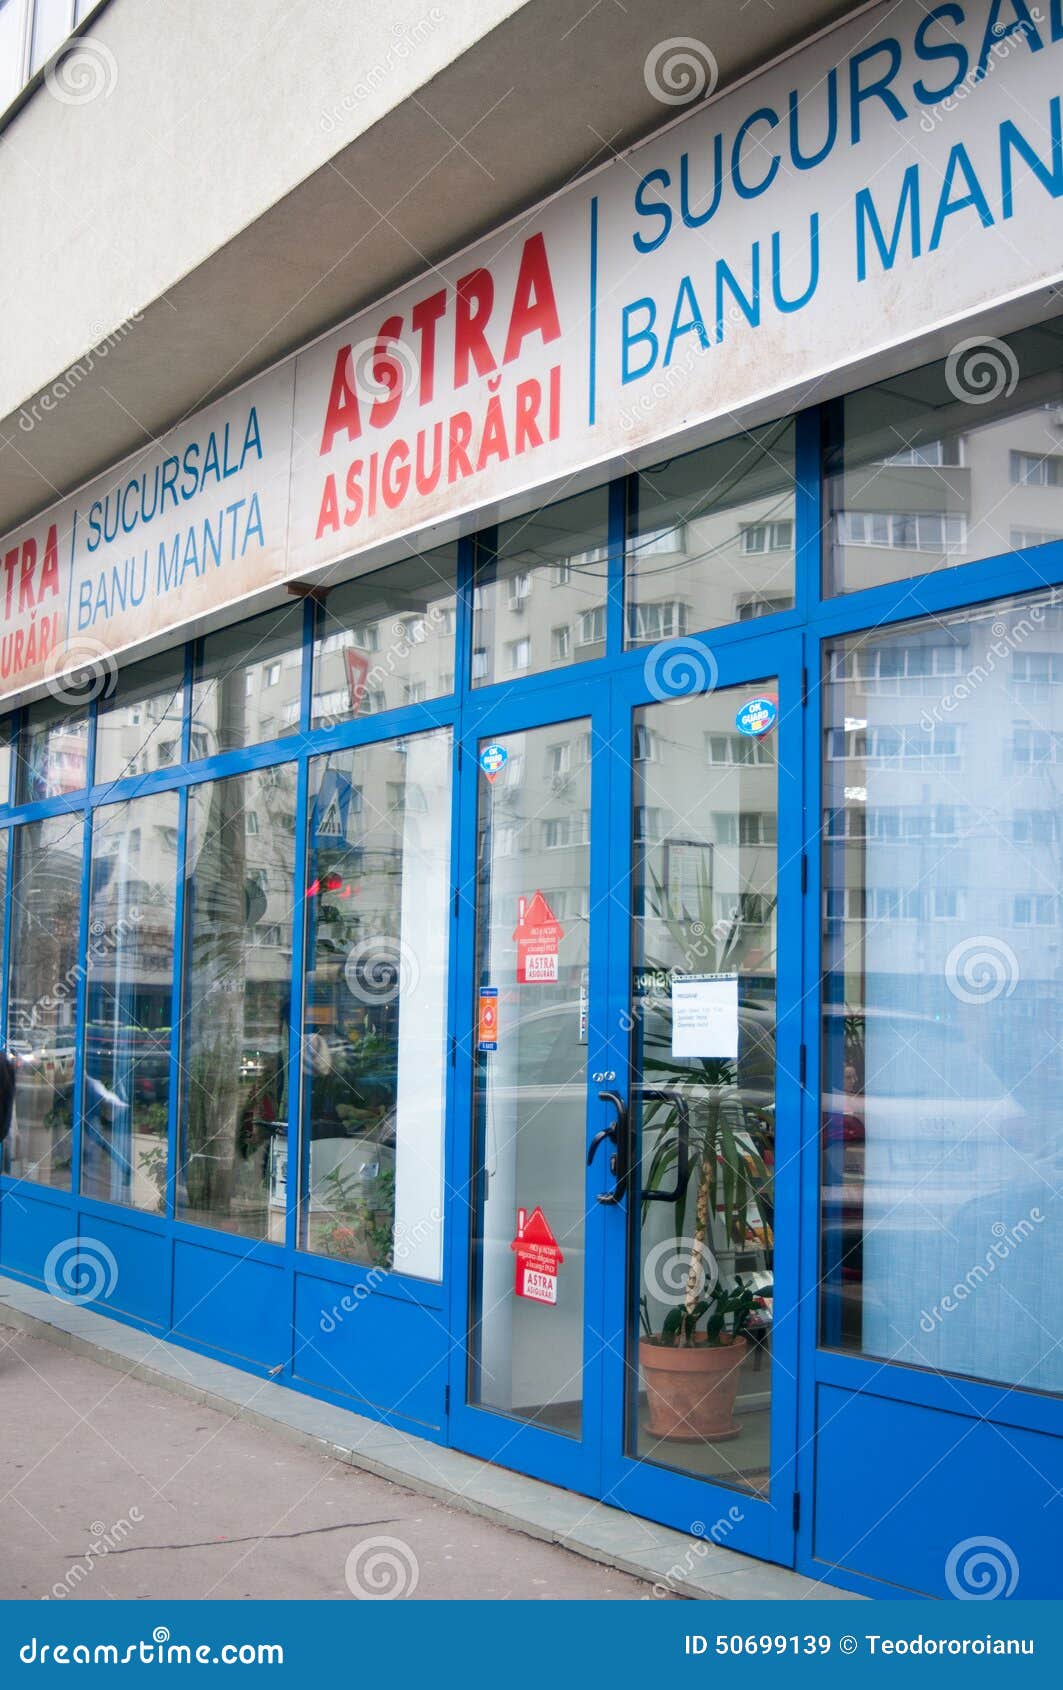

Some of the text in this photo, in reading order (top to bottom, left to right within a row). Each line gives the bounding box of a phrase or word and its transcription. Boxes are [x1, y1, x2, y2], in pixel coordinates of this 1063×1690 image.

[633, 0, 1063, 254] SUCURSA
[319, 231, 562, 457] ASTRA
[621, 211, 819, 386] BANU
[87, 406, 263, 553] SUCURSALA
[315, 364, 562, 540] ASIGURĂRI
[0, 524, 60, 621] TRA
[78, 491, 264, 631] BANU MANTA
[742, 709, 768, 724] GUARD
[749, 703, 761, 713] OK
[529, 957, 555, 970] ASTRA
[528, 1273, 553, 1290] ASTRA
